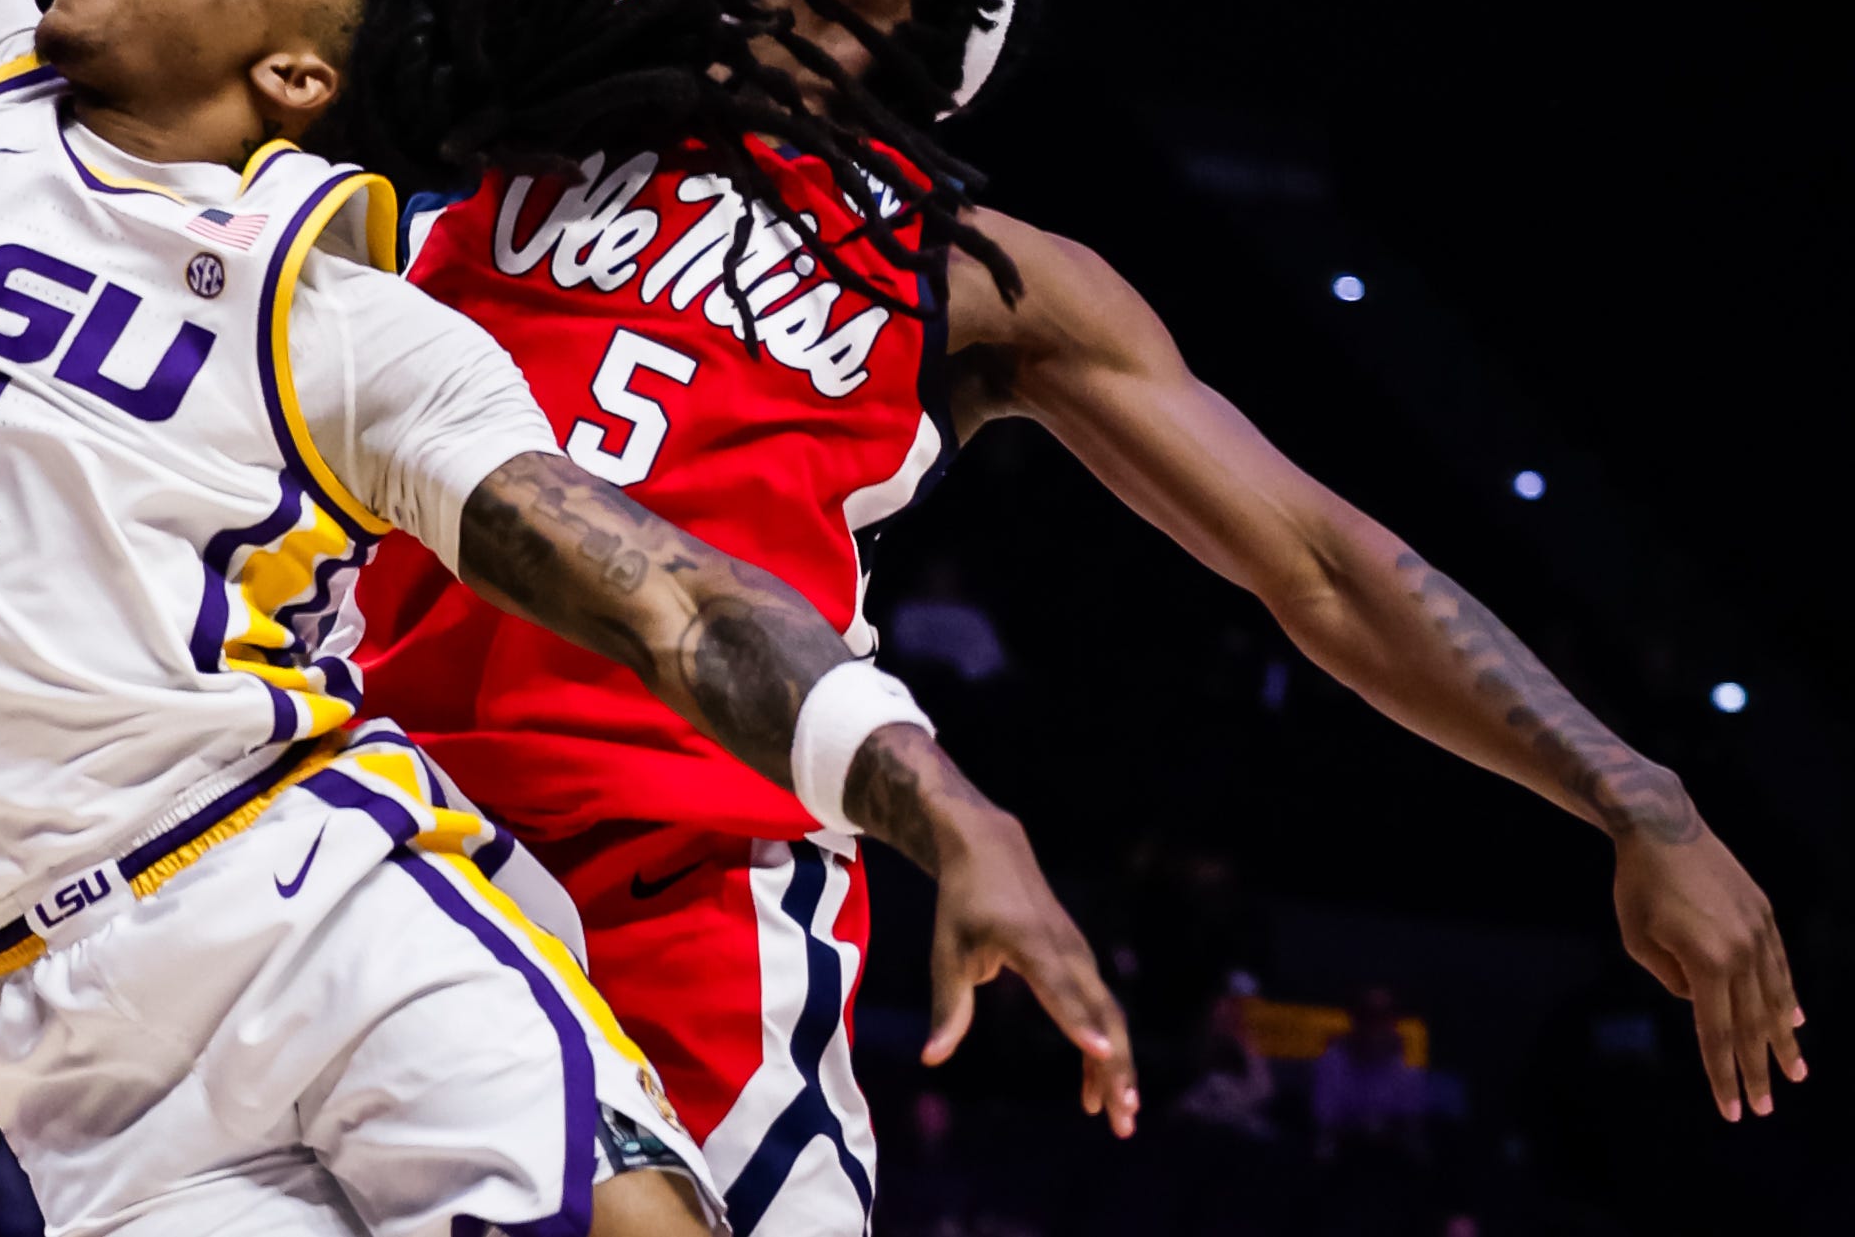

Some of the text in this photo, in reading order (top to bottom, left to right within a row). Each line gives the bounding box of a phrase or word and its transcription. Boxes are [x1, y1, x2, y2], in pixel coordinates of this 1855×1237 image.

[188, 254, 223, 296] SEC
[641, 172, 890, 398] Miss
[566, 326, 697, 487] 5
[34, 869, 111, 929] LSU
